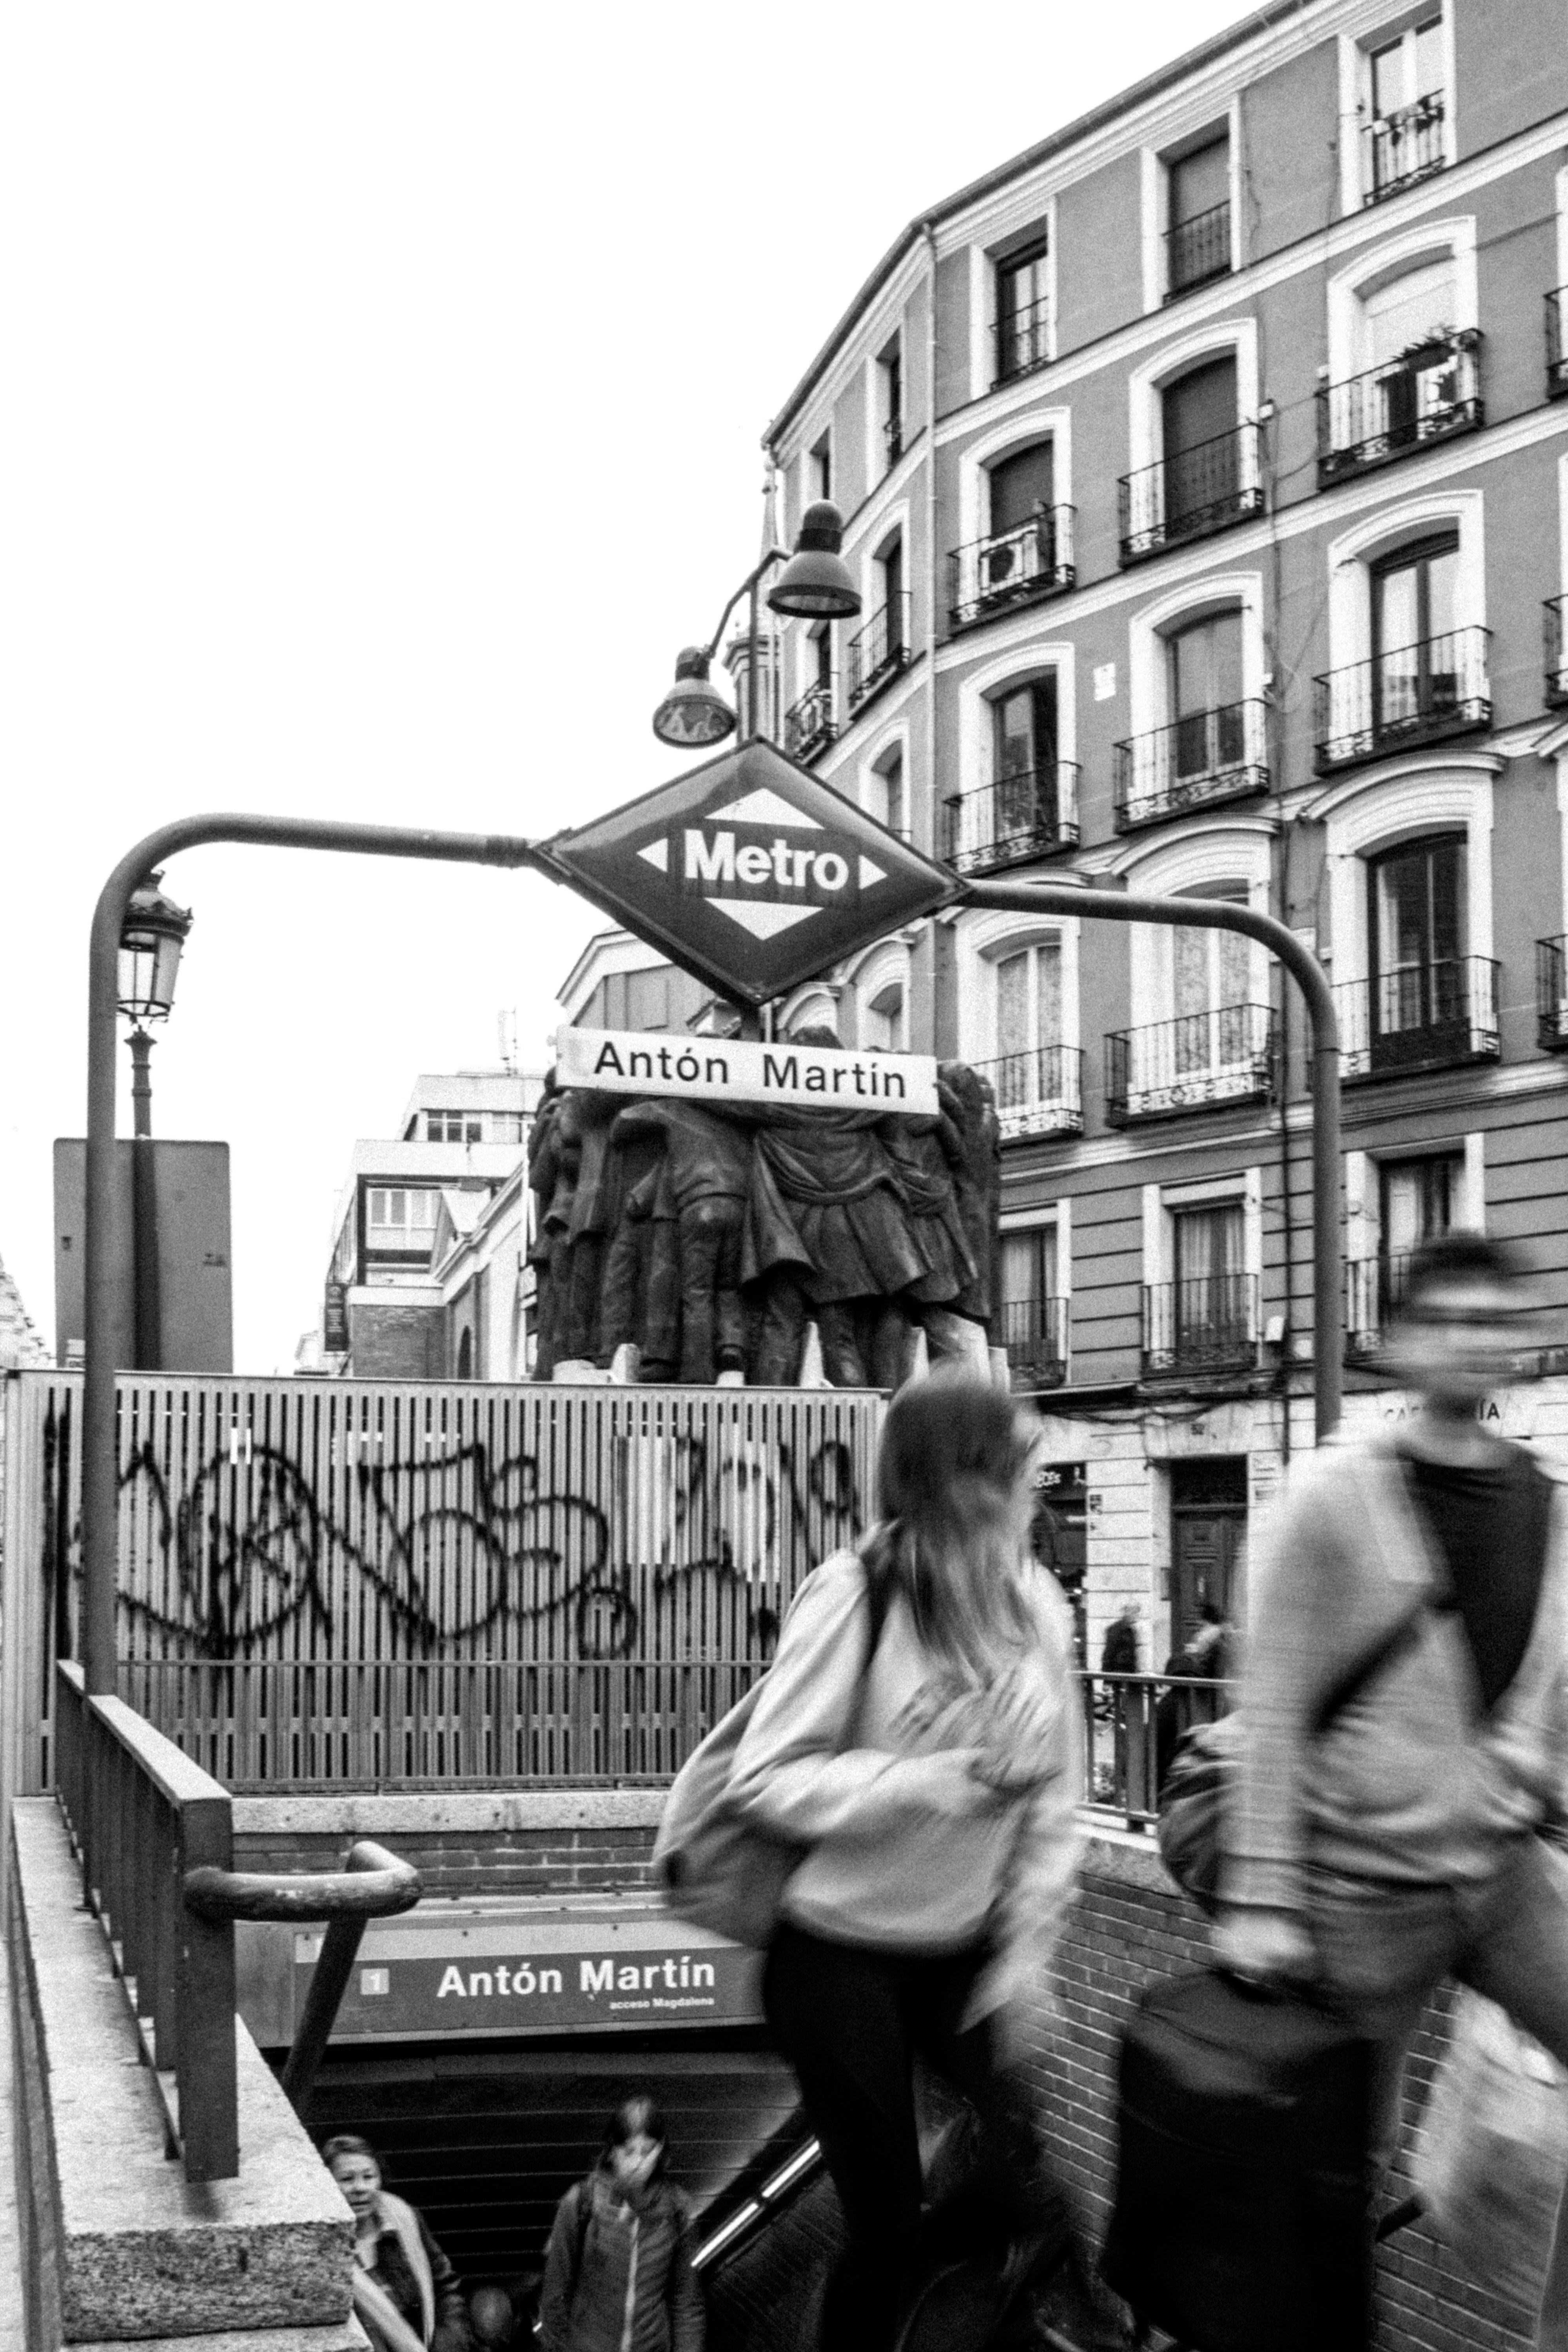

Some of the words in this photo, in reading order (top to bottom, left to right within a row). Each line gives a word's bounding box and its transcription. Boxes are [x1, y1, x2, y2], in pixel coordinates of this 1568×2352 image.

[684, 828, 849, 891] Metro
[593, 1041, 729, 1084] Antón
[763, 1053, 906, 1099] Martín
[370, 1973, 381, 1991] 1
[436, 1962, 562, 1998] Antón
[580, 1955, 715, 1993] Martín
[609, 2000, 651, 2010] acceso
[652, 1997, 715, 2009] Magdalena
